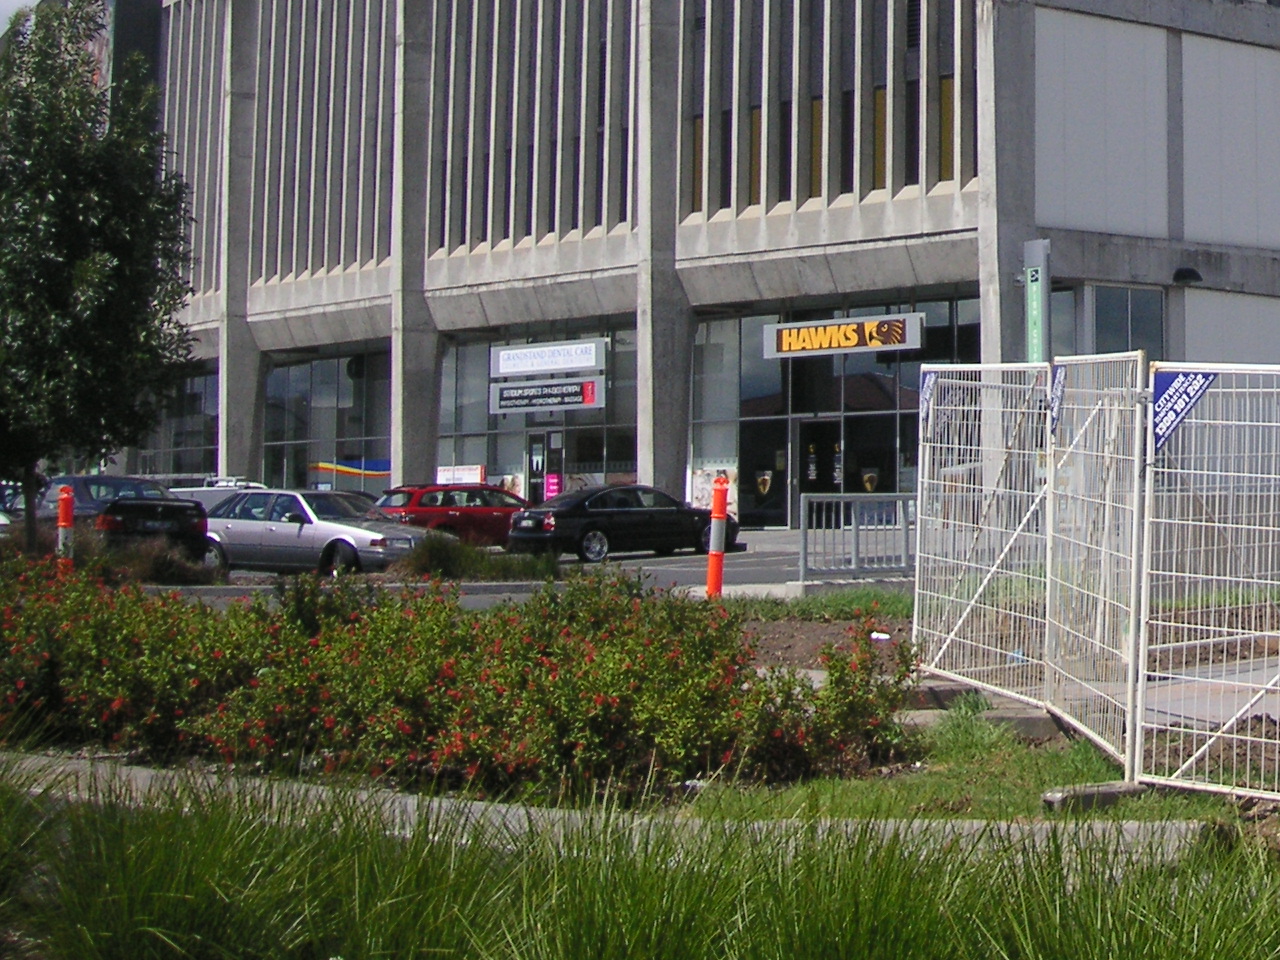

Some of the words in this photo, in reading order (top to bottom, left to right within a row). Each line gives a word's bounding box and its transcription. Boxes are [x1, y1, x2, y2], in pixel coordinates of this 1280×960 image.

[548, 348, 573, 358] DENTAL
[574, 345, 593, 356] CARE
[782, 323, 859, 351] HAWKS
[1154, 373, 1186, 411] CITYWIDE
[1155, 410, 1176, 435] 1300
[1173, 394, 1189, 413] 101
